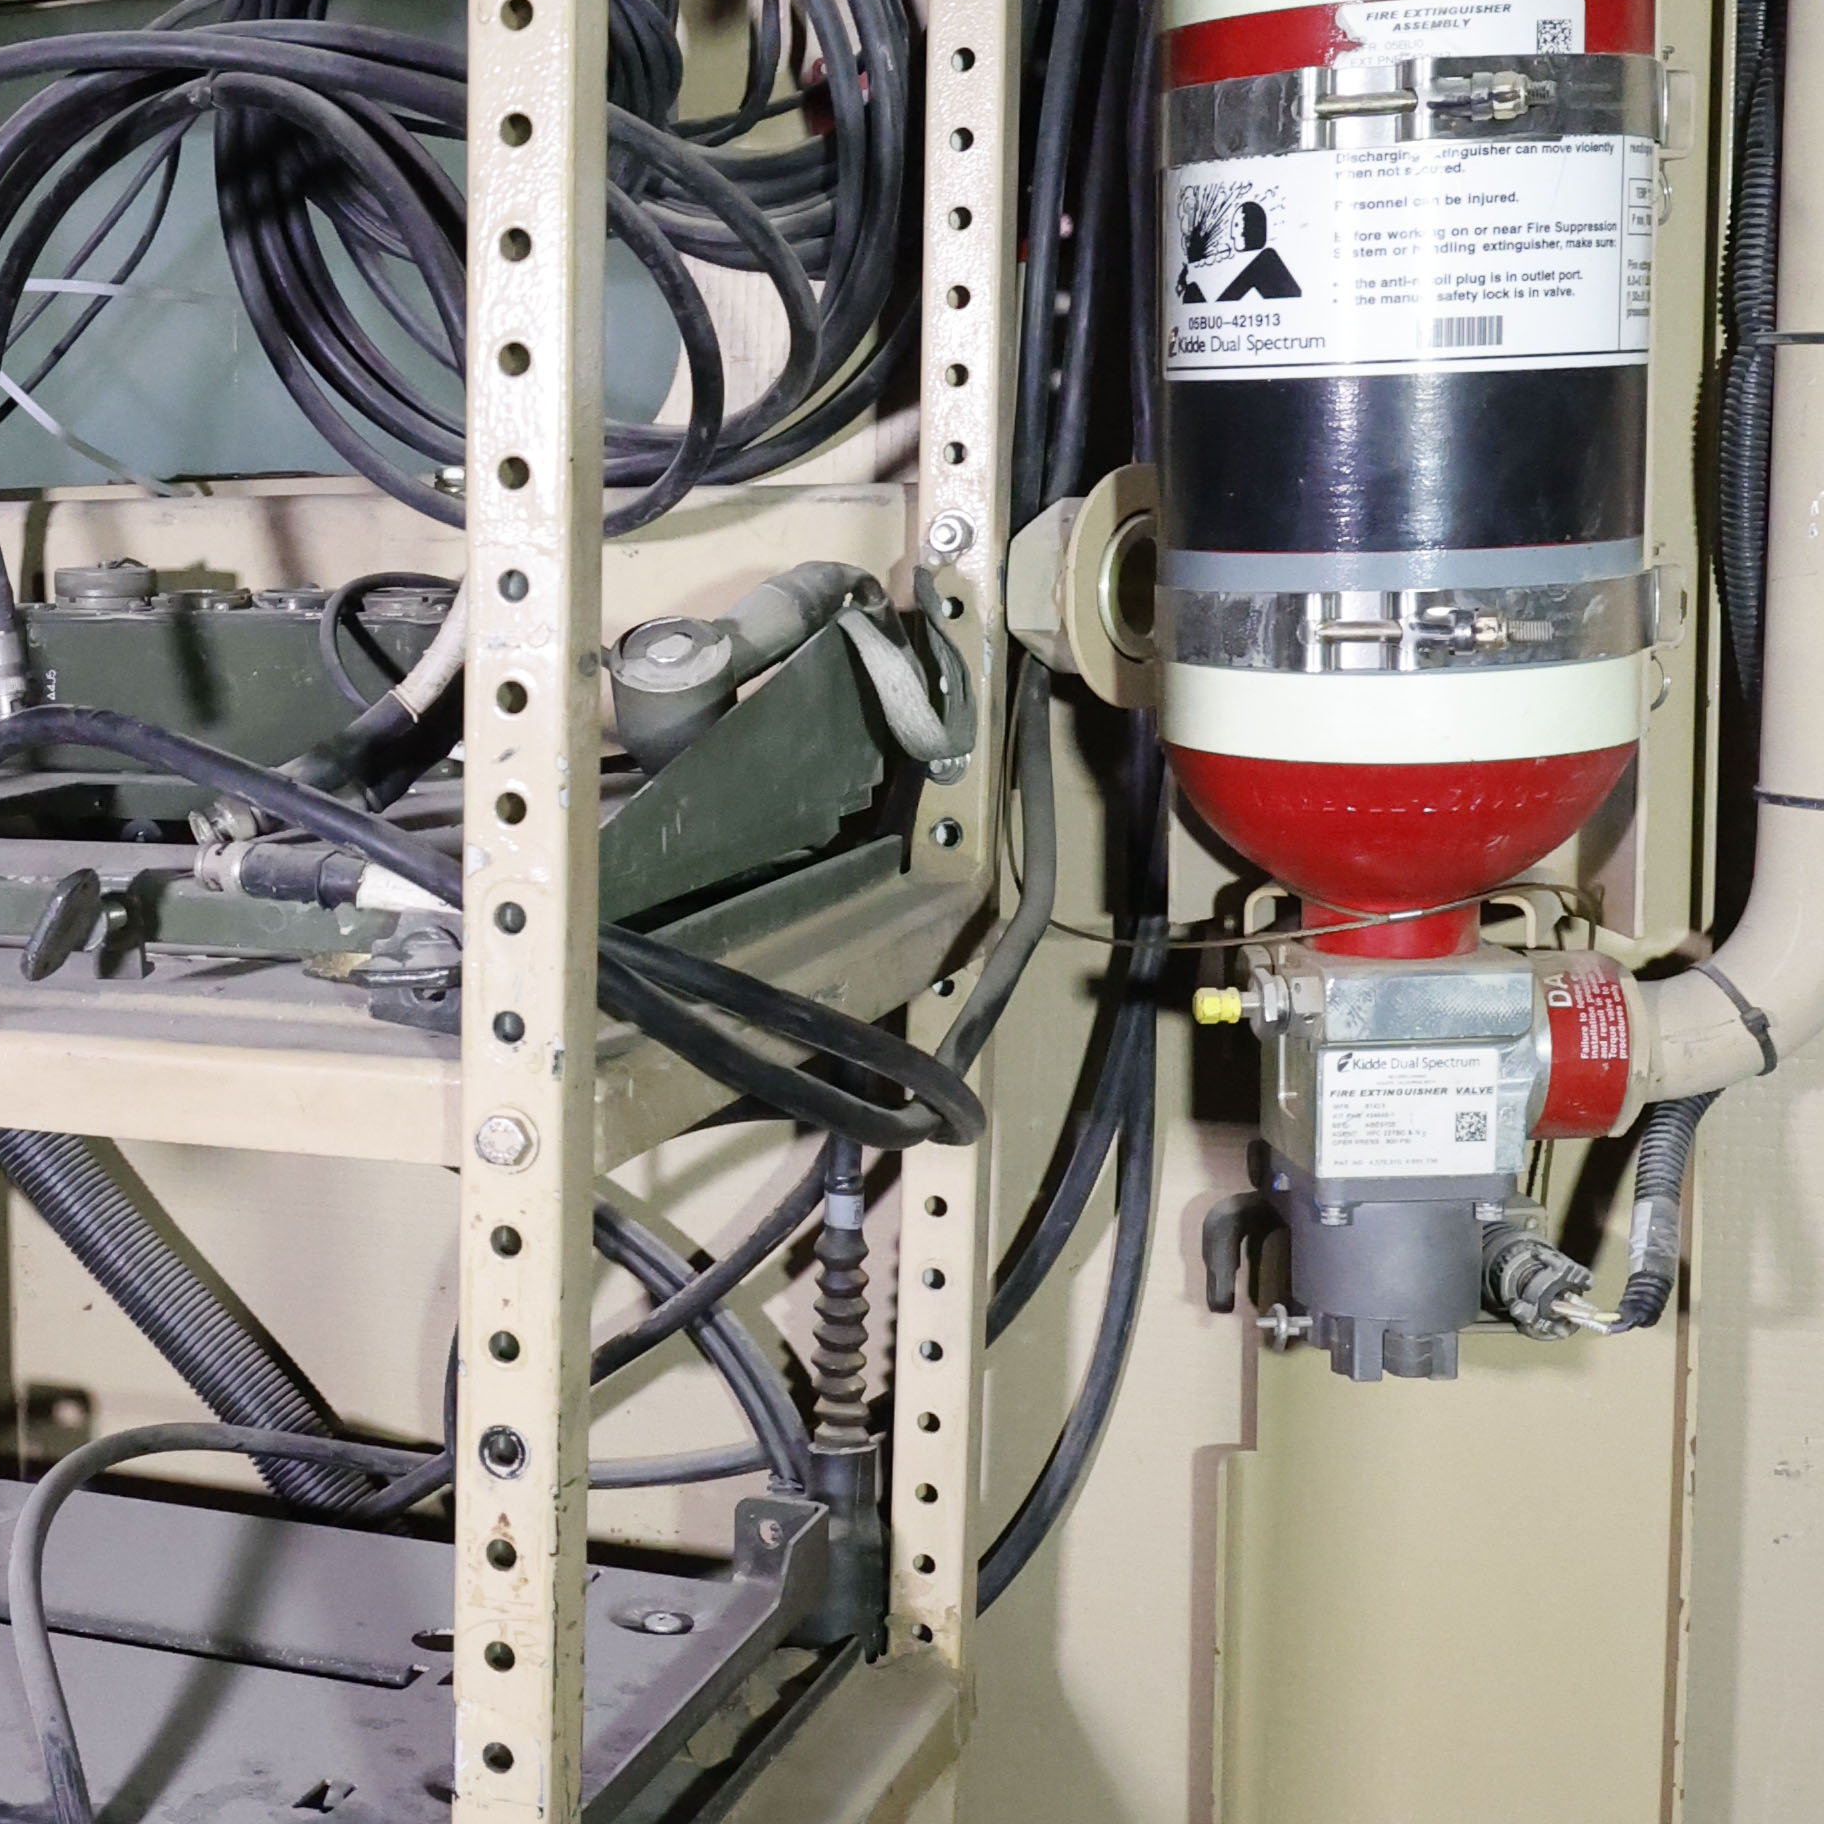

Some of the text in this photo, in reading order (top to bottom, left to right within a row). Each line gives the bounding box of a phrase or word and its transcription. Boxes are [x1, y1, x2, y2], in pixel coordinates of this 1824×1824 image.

[1366, 3, 1512, 22] FIRE EXTINGUISHER
[1392, 17, 1472, 32] ASSEMBLY
[1515, 145, 1538, 155] can
[1541, 144, 1573, 154] move
[1575, 141, 1615, 156] violently
[1376, 166, 1402, 179] not
[1444, 193, 1462, 206] be
[1467, 191, 1520, 207] injured.
[1451, 225, 1470, 237] on
[1474, 224, 1488, 236] or
[1492, 223, 1523, 236] near
[1526, 221, 1551, 234] Fire
[1554, 220, 1618, 235] Suppression
[1392, 245, 1407, 257] or
[1481, 237, 1564, 254] extinguisher,
[1565, 236, 1593, 250] make
[1354, 276, 1377, 290] the
[1455, 271, 1487, 287] plug
[1490, 270, 1502, 284] is
[1505, 270, 1518, 283] in
[1520, 269, 1556, 282] outlet
[1436, 289, 1479, 304] safety
[1482, 287, 1510, 300] lock
[1513, 287, 1525, 299] is
[1528, 286, 1540, 298] in
[1542, 285, 1576, 299] valve.
[1188, 313, 1281, 331] 05BU0-421913
[1177, 333, 1326, 357] Kidde Dual Spectrum
[1578, 1012, 1588, 1023] to
[1604, 998, 1615, 1022] valve
[1596, 1009, 1608, 1037] result
[1616, 1005, 1628, 1060] procedures
[1580, 1025, 1590, 1060] Failure
[1599, 1040, 1608, 1060] and
[1607, 1025, 1618, 1060] Torque
[1352, 1056, 1481, 1071] Kidde Dual Spectrum
[1329, 1086, 1494, 1098] FIRE EXTINGUISHER VALVE
